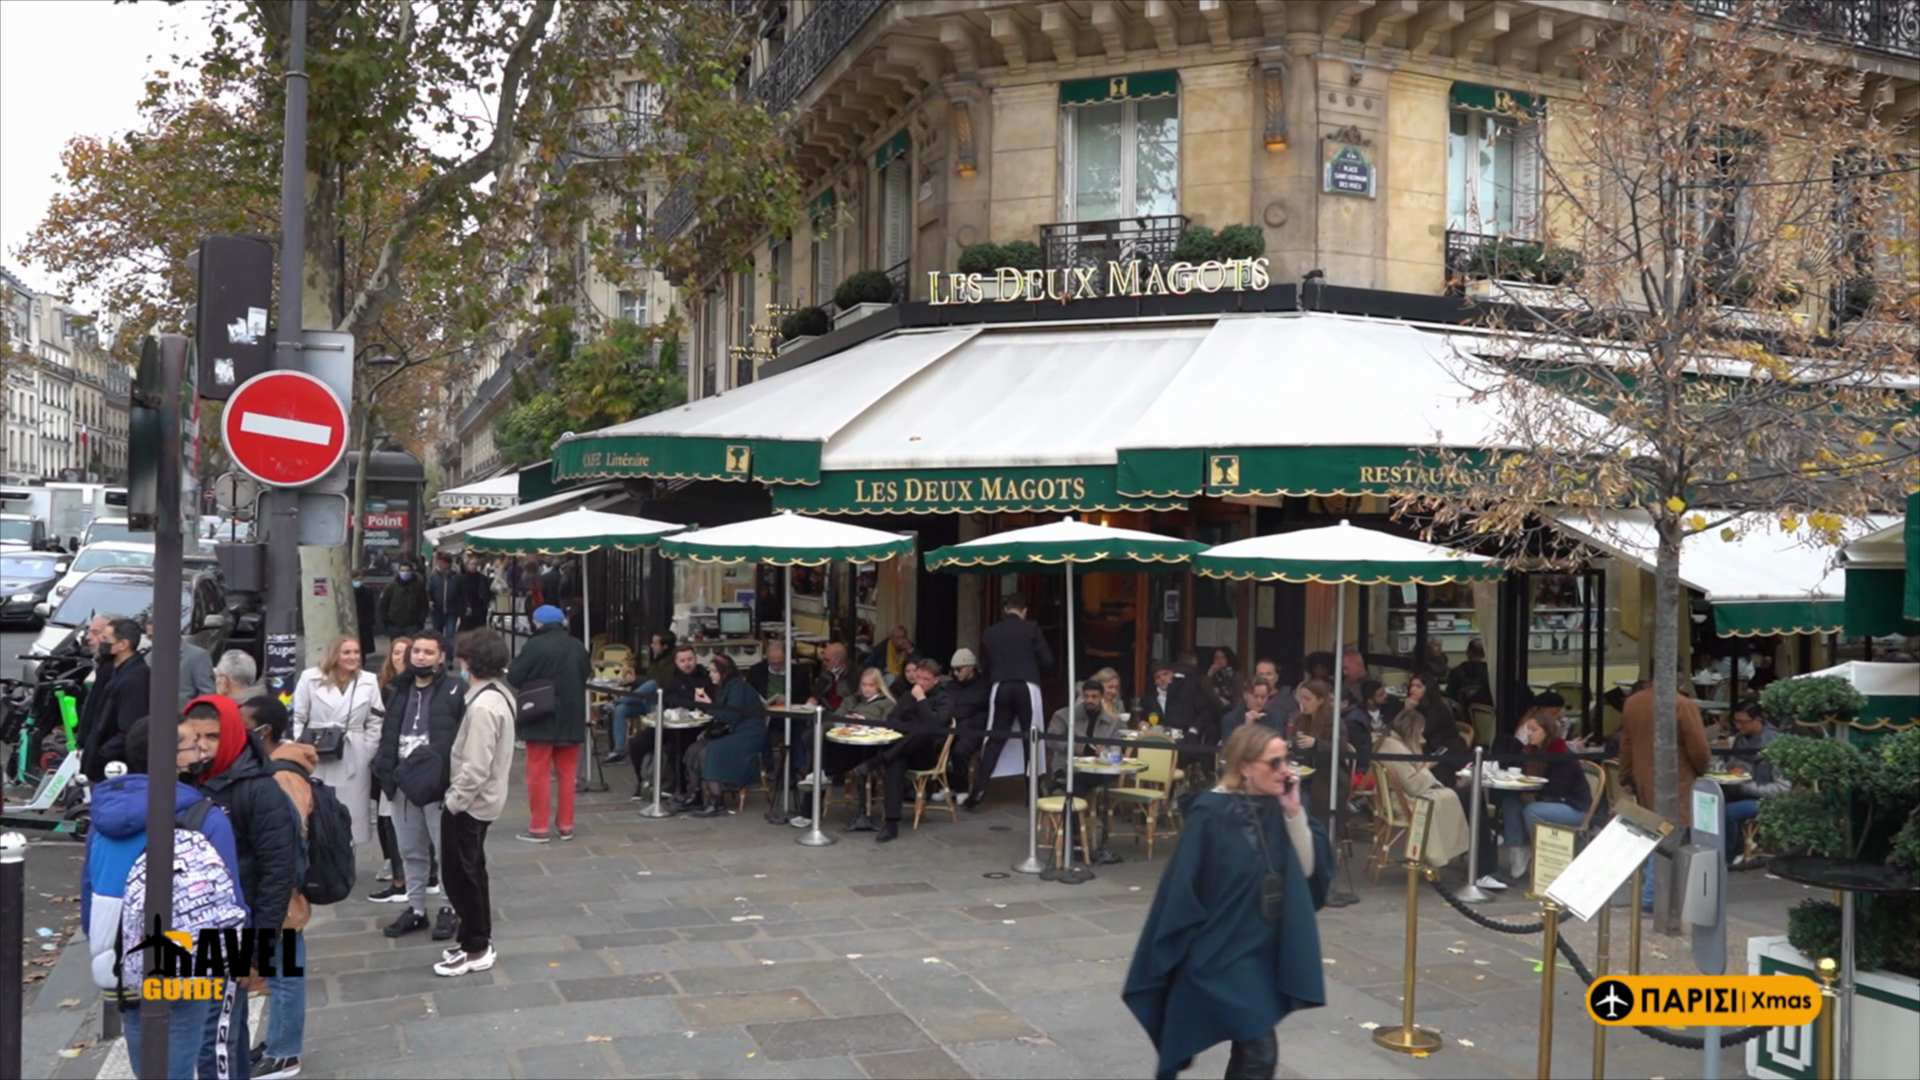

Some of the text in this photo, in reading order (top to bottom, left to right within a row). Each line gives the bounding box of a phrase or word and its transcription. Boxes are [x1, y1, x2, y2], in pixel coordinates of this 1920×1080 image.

[927, 257, 1270, 305] LES DEUX MAGOTS
[1360, 465, 1506, 486] RESTAU
[855, 477, 1085, 503] LES DEUX MAGOTS
[368, 514, 403, 527] Point
